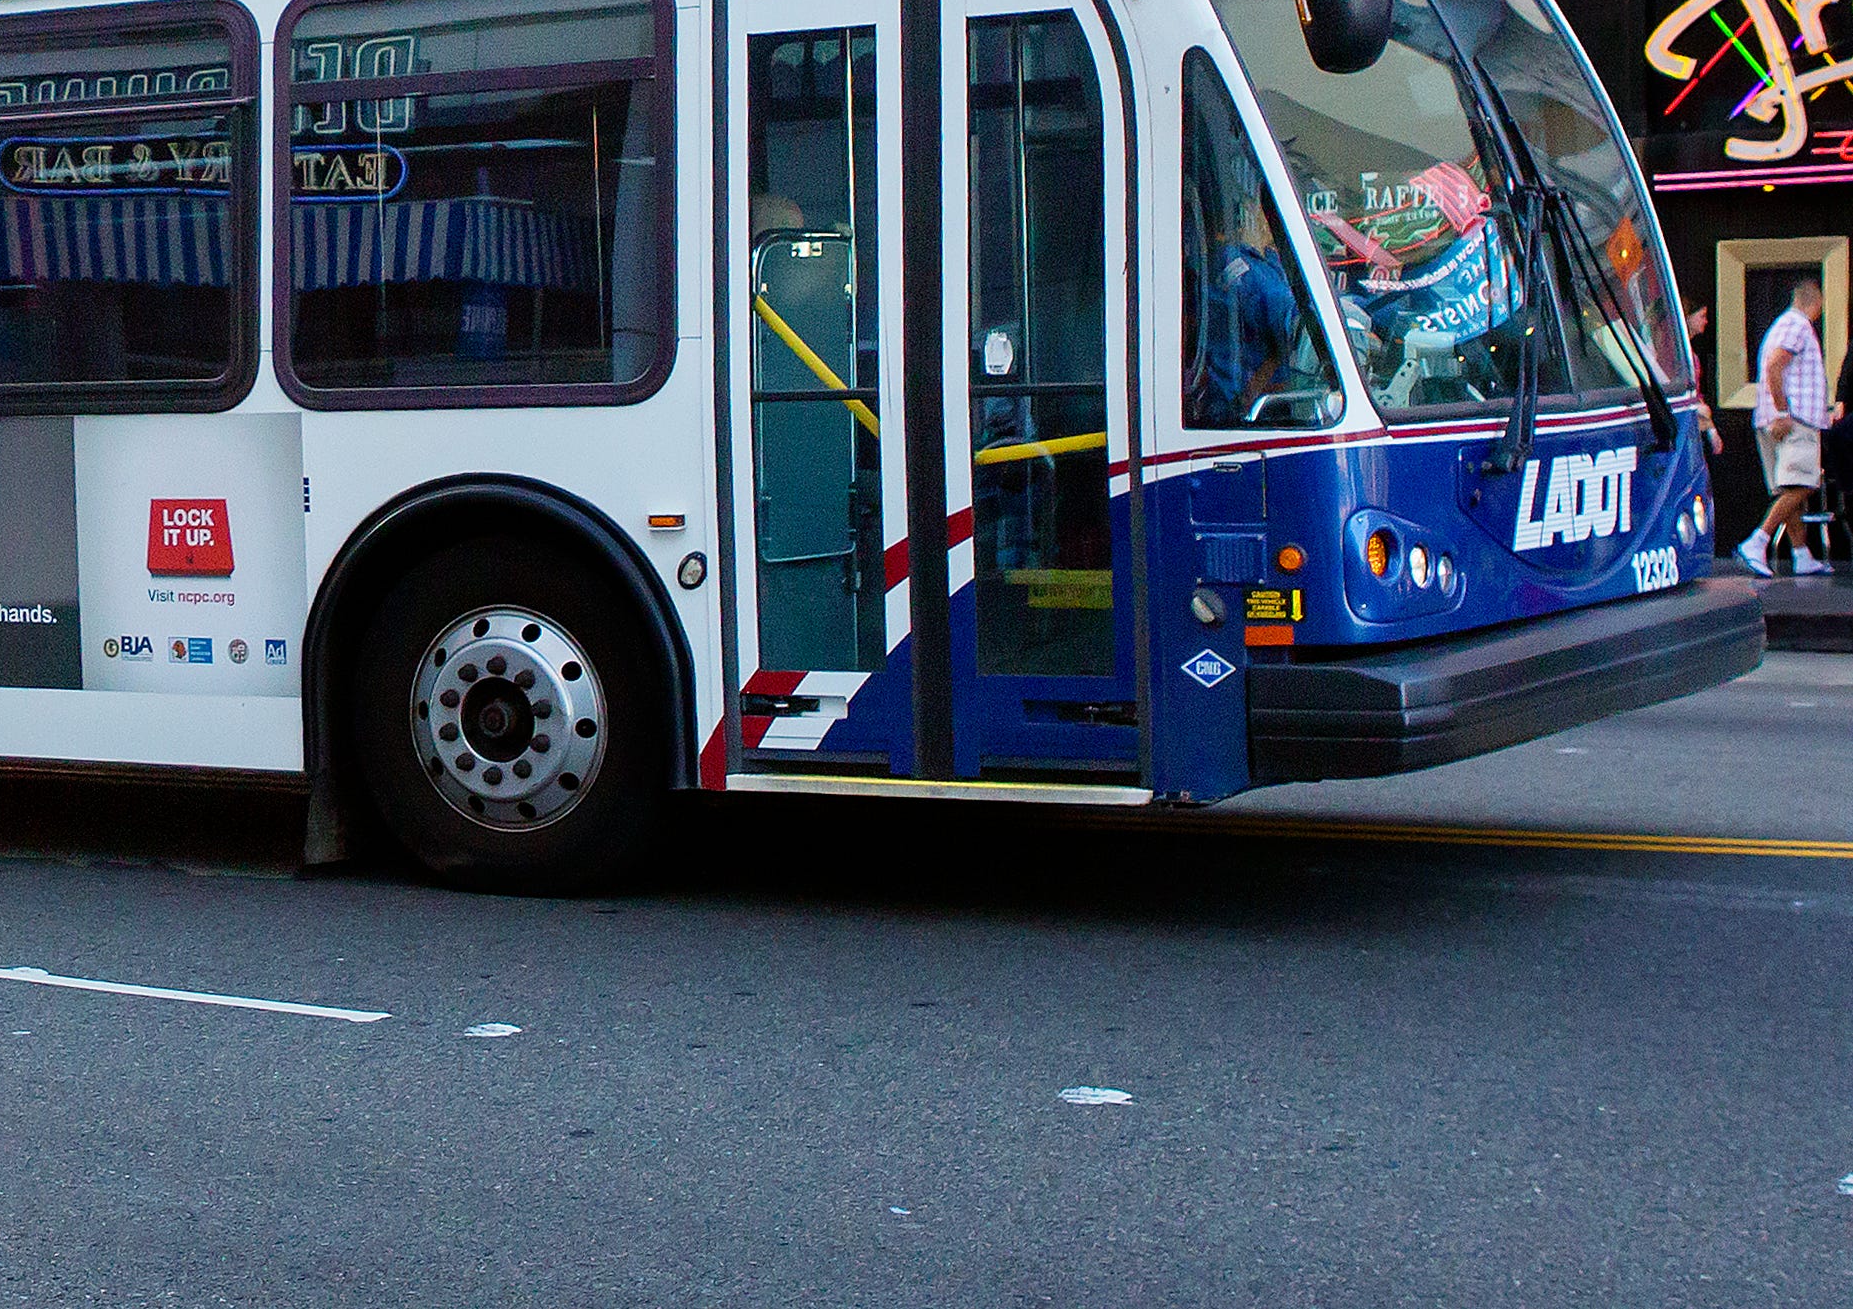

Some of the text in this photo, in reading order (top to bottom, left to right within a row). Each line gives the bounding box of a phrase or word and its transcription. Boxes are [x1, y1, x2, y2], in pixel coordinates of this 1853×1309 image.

[1513, 445, 1638, 552] LADOT
[162, 508, 215, 527] LOCK
[163, 528, 215, 546] IT UP.
[1631, 545, 1680, 593] 12328
[148, 588, 235, 606] Visit ncpc.org
[121, 635, 153, 655] BJA
[266, 643, 286, 658] Ad
